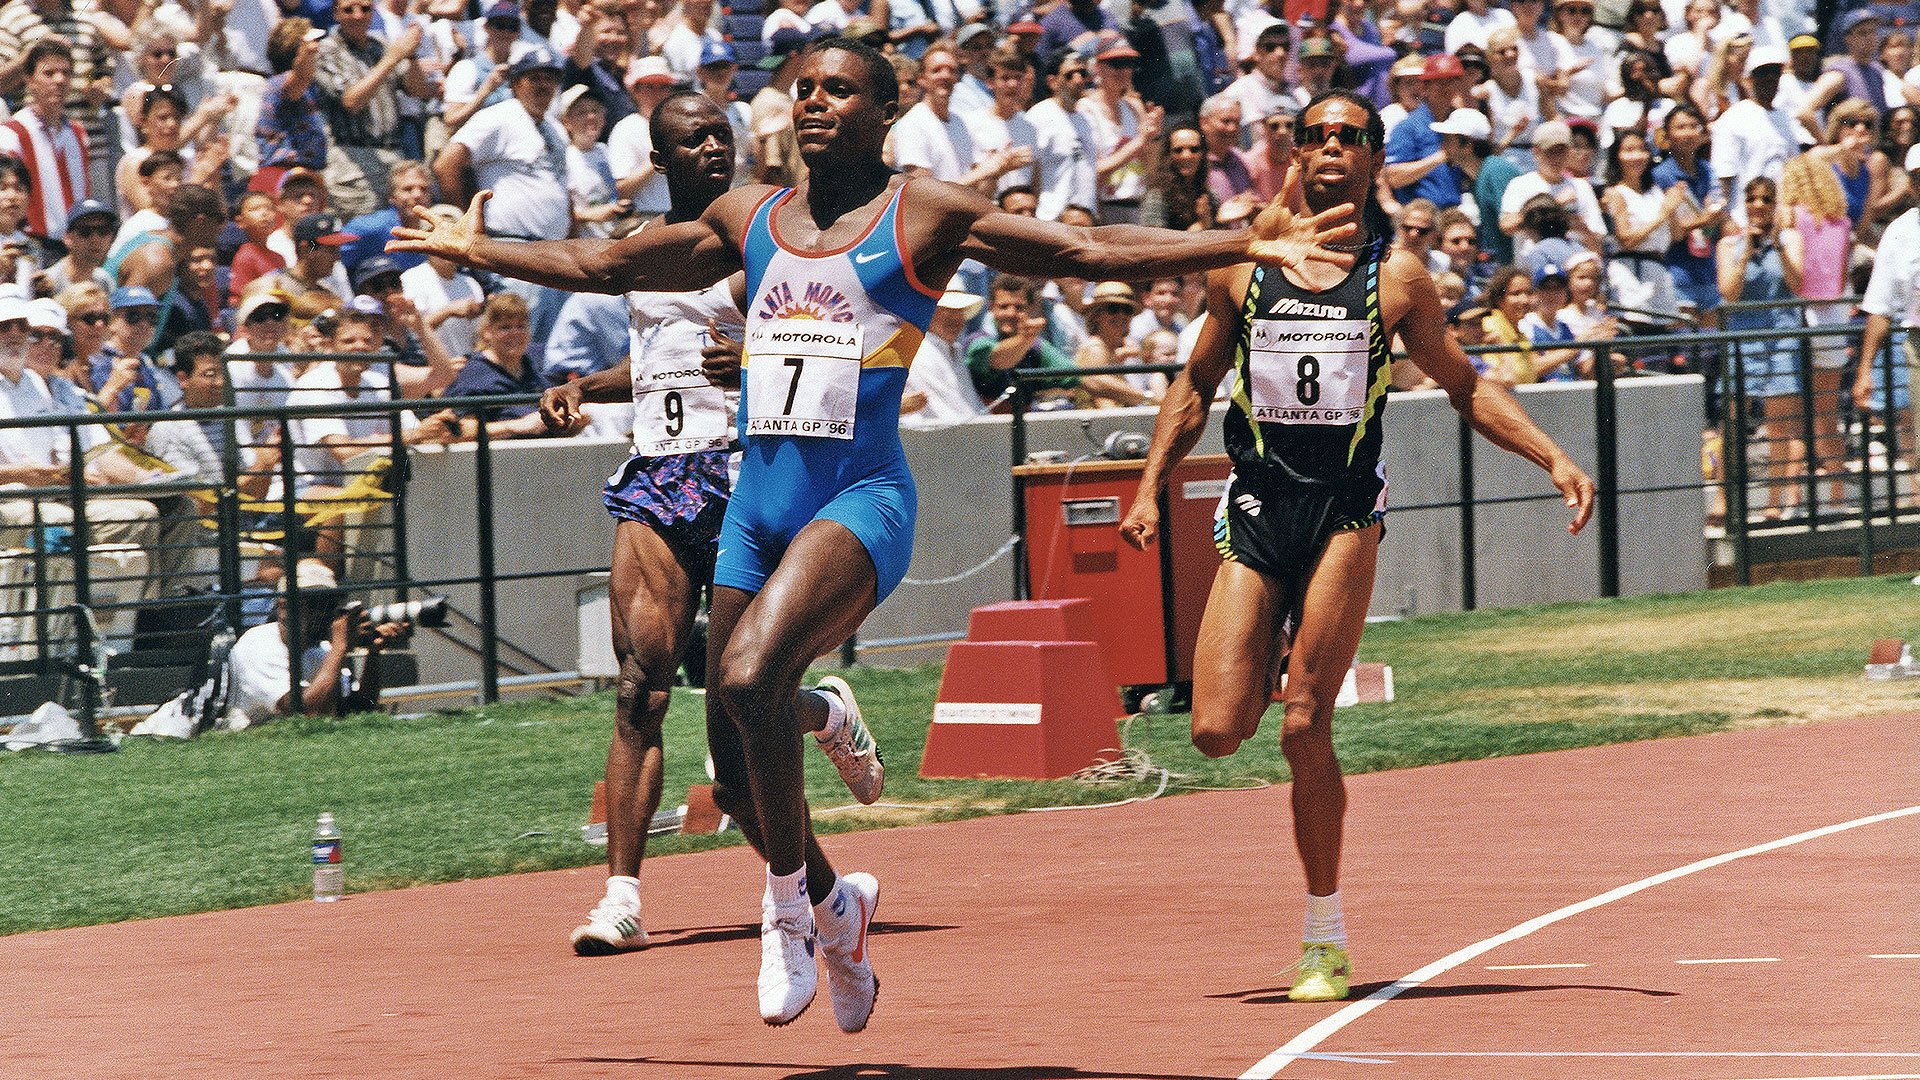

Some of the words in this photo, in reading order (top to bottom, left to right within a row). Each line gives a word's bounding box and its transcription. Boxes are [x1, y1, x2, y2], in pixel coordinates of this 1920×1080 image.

[803, 281, 854, 322] MONIC
[772, 332, 857, 346] MOTOROLA
[1278, 331, 1365, 342] MOTOROLA
[652, 368, 706, 381] MOTORO
[1297, 355, 1320, 406] 8
[783, 357, 804, 416] 7
[664, 391, 684, 437] 9
[1256, 408, 1320, 421] ATLANTA
[1324, 411, 1343, 421] GP
[802, 421, 821, 433] GP
[826, 422, 848, 435] '96
